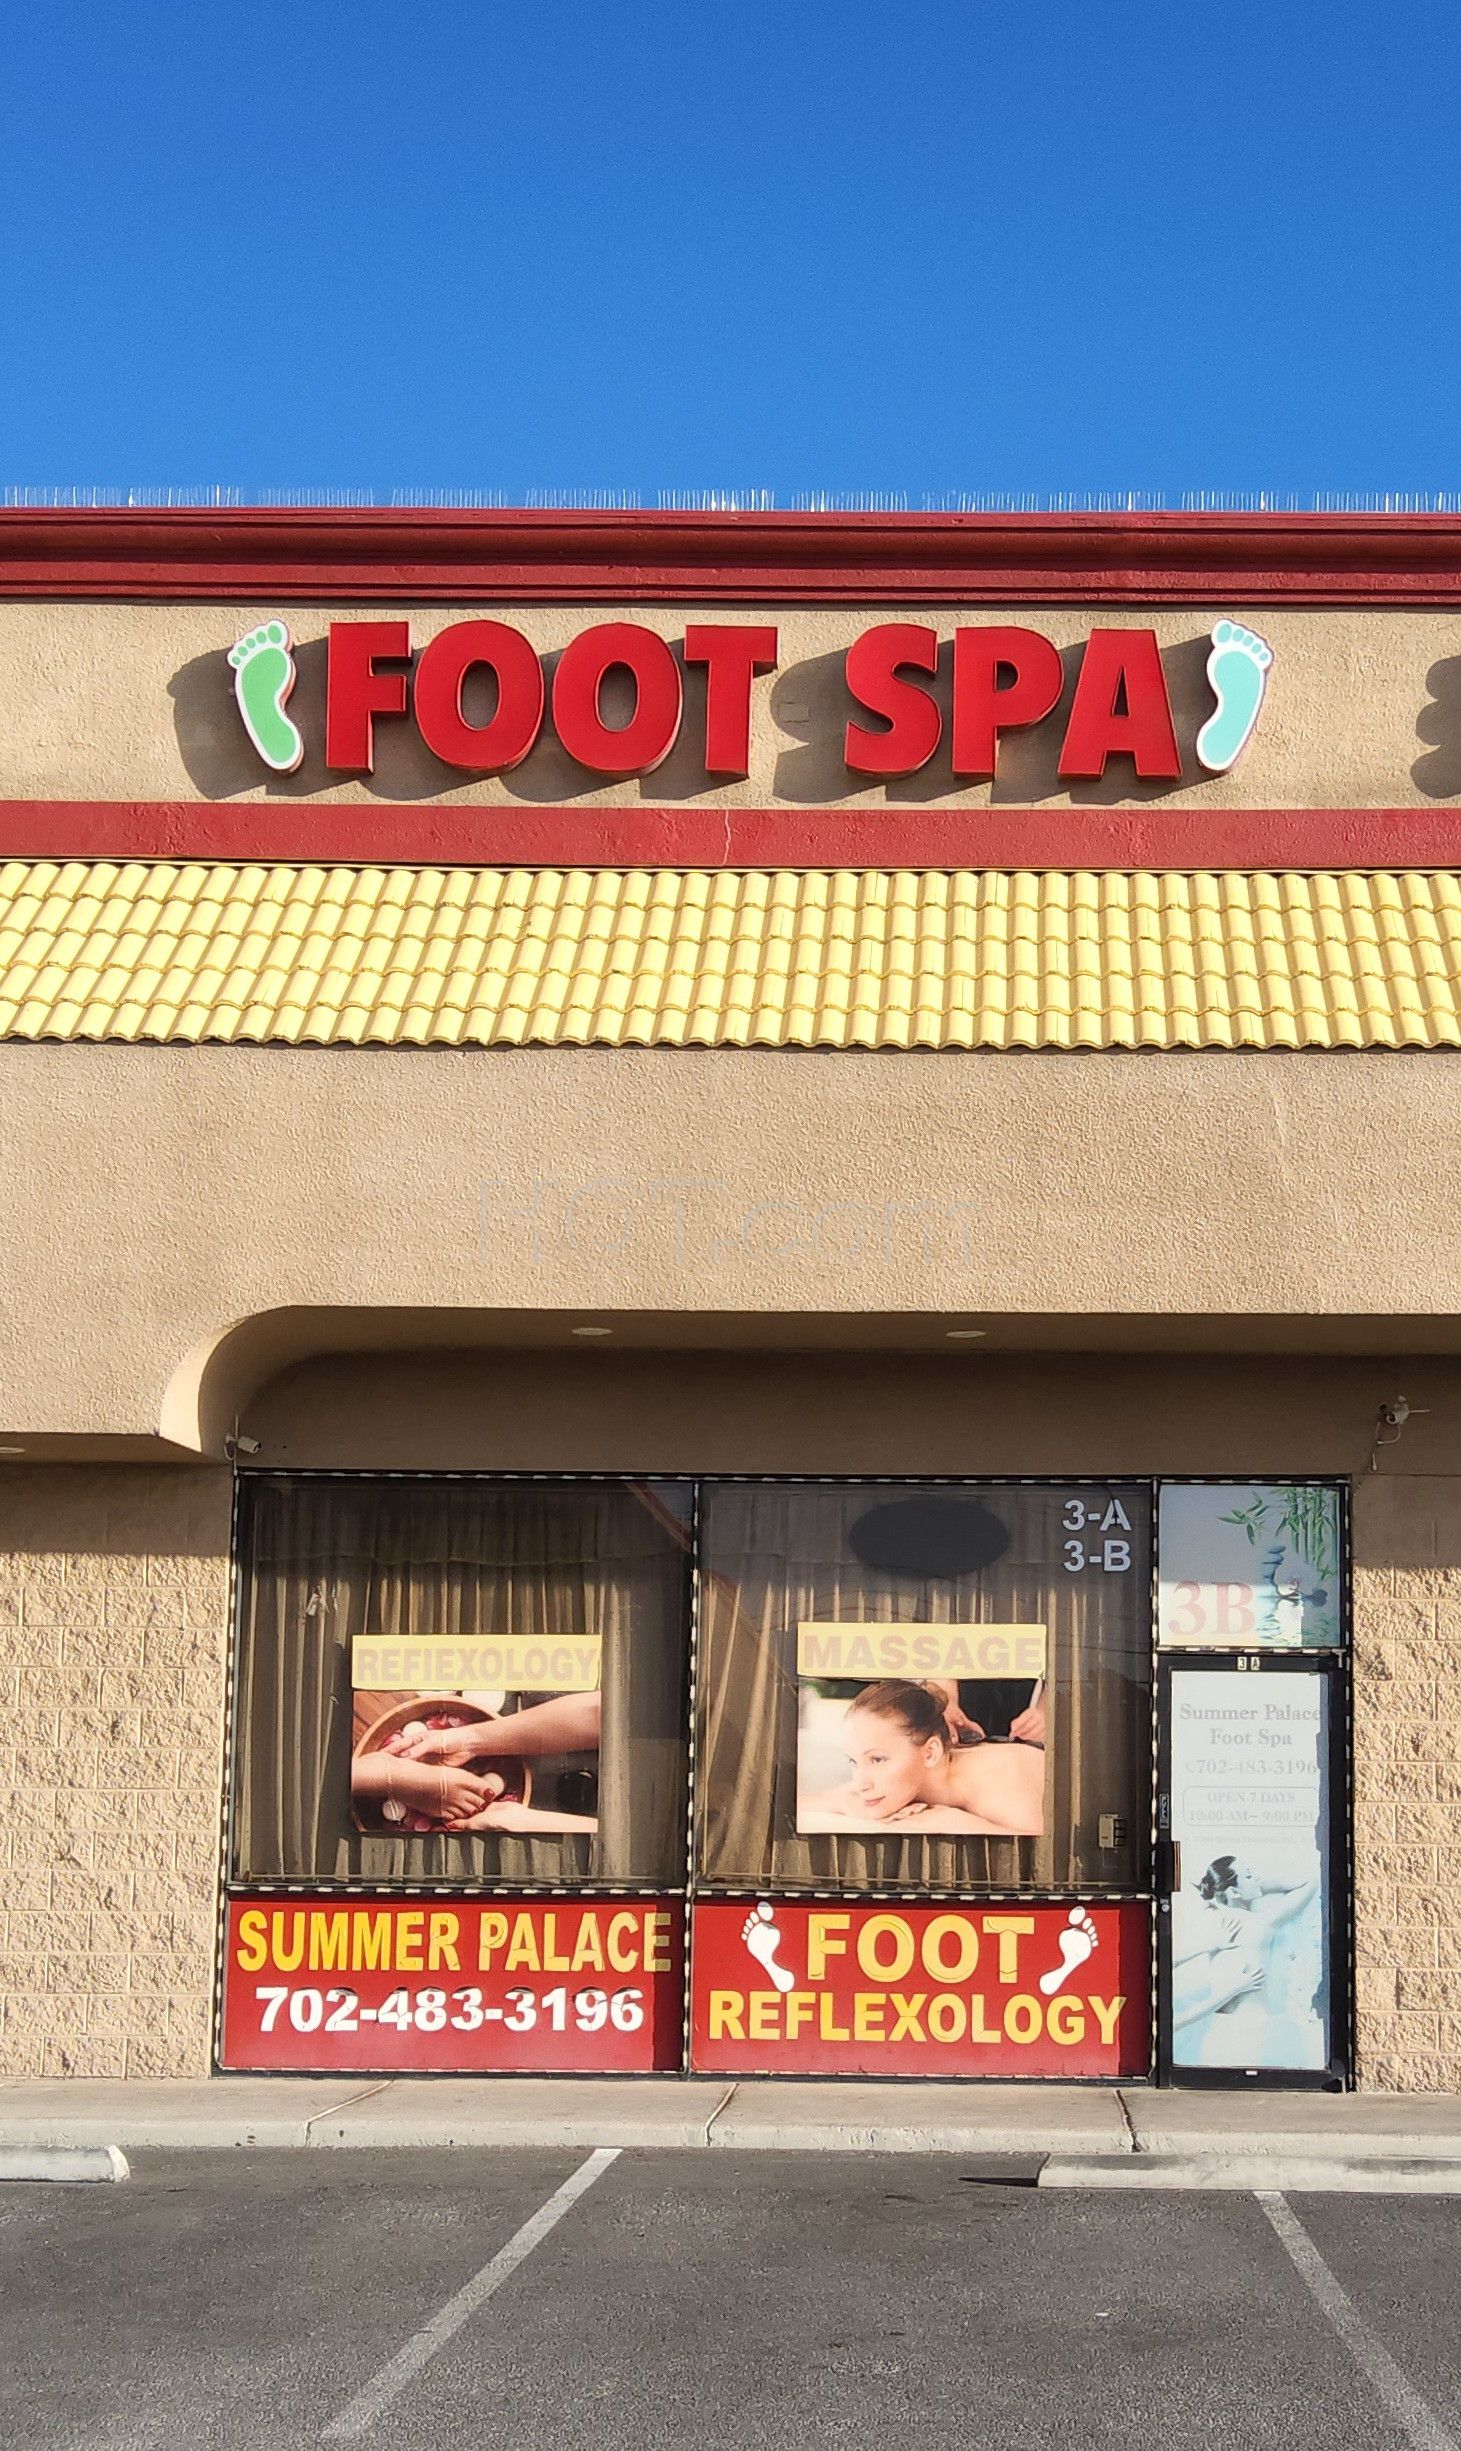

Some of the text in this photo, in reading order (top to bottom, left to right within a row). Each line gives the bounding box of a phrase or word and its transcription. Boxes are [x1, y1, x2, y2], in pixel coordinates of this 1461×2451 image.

[326, 619, 1182, 778] FOOT SPA
[1062, 1500, 1132, 1532] 3-A
[1063, 1539, 1131, 1573] 3-B
[1167, 1580, 1256, 1636] 3B
[356, 1647, 599, 1682] REFIEXOLOGY
[803, 1635, 1043, 1672] MASSAGE
[1180, 1703, 1320, 1721] Summer Palace
[1209, 1727, 1293, 1749] Foot Spa
[1207, 1791, 1296, 1804] OPEN 7 DAYS
[236, 1909, 672, 1973] SUMMER PALACE
[807, 1913, 1035, 1984] FOOT
[255, 1985, 645, 2032] 702-483-3196
[708, 1990, 1127, 2045] REFLEXOLOGY
